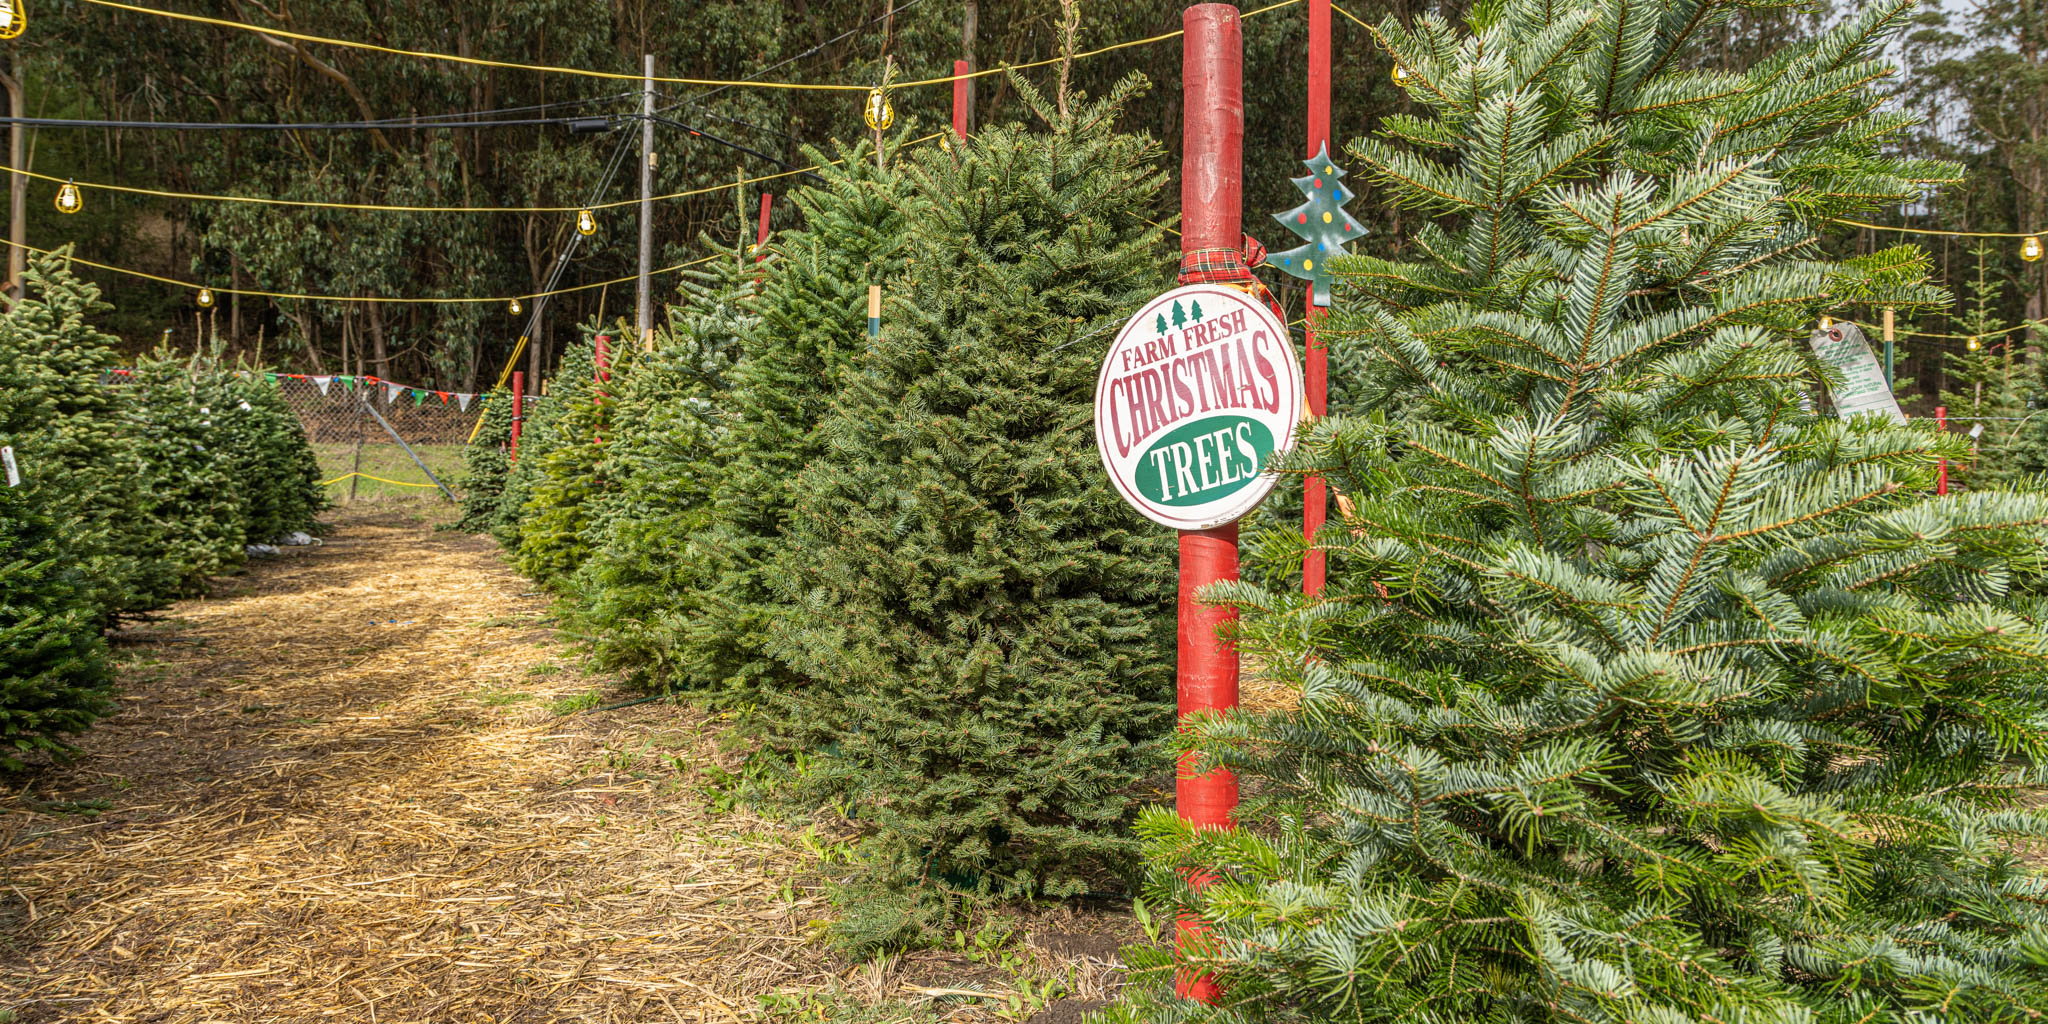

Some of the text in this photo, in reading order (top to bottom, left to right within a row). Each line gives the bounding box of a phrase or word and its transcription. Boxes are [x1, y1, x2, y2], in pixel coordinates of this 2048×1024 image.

[1121, 308, 1248, 372] FARM FRESH
[1109, 330, 1280, 459] CHRISTMAS
[1150, 421, 1259, 502] TREES
